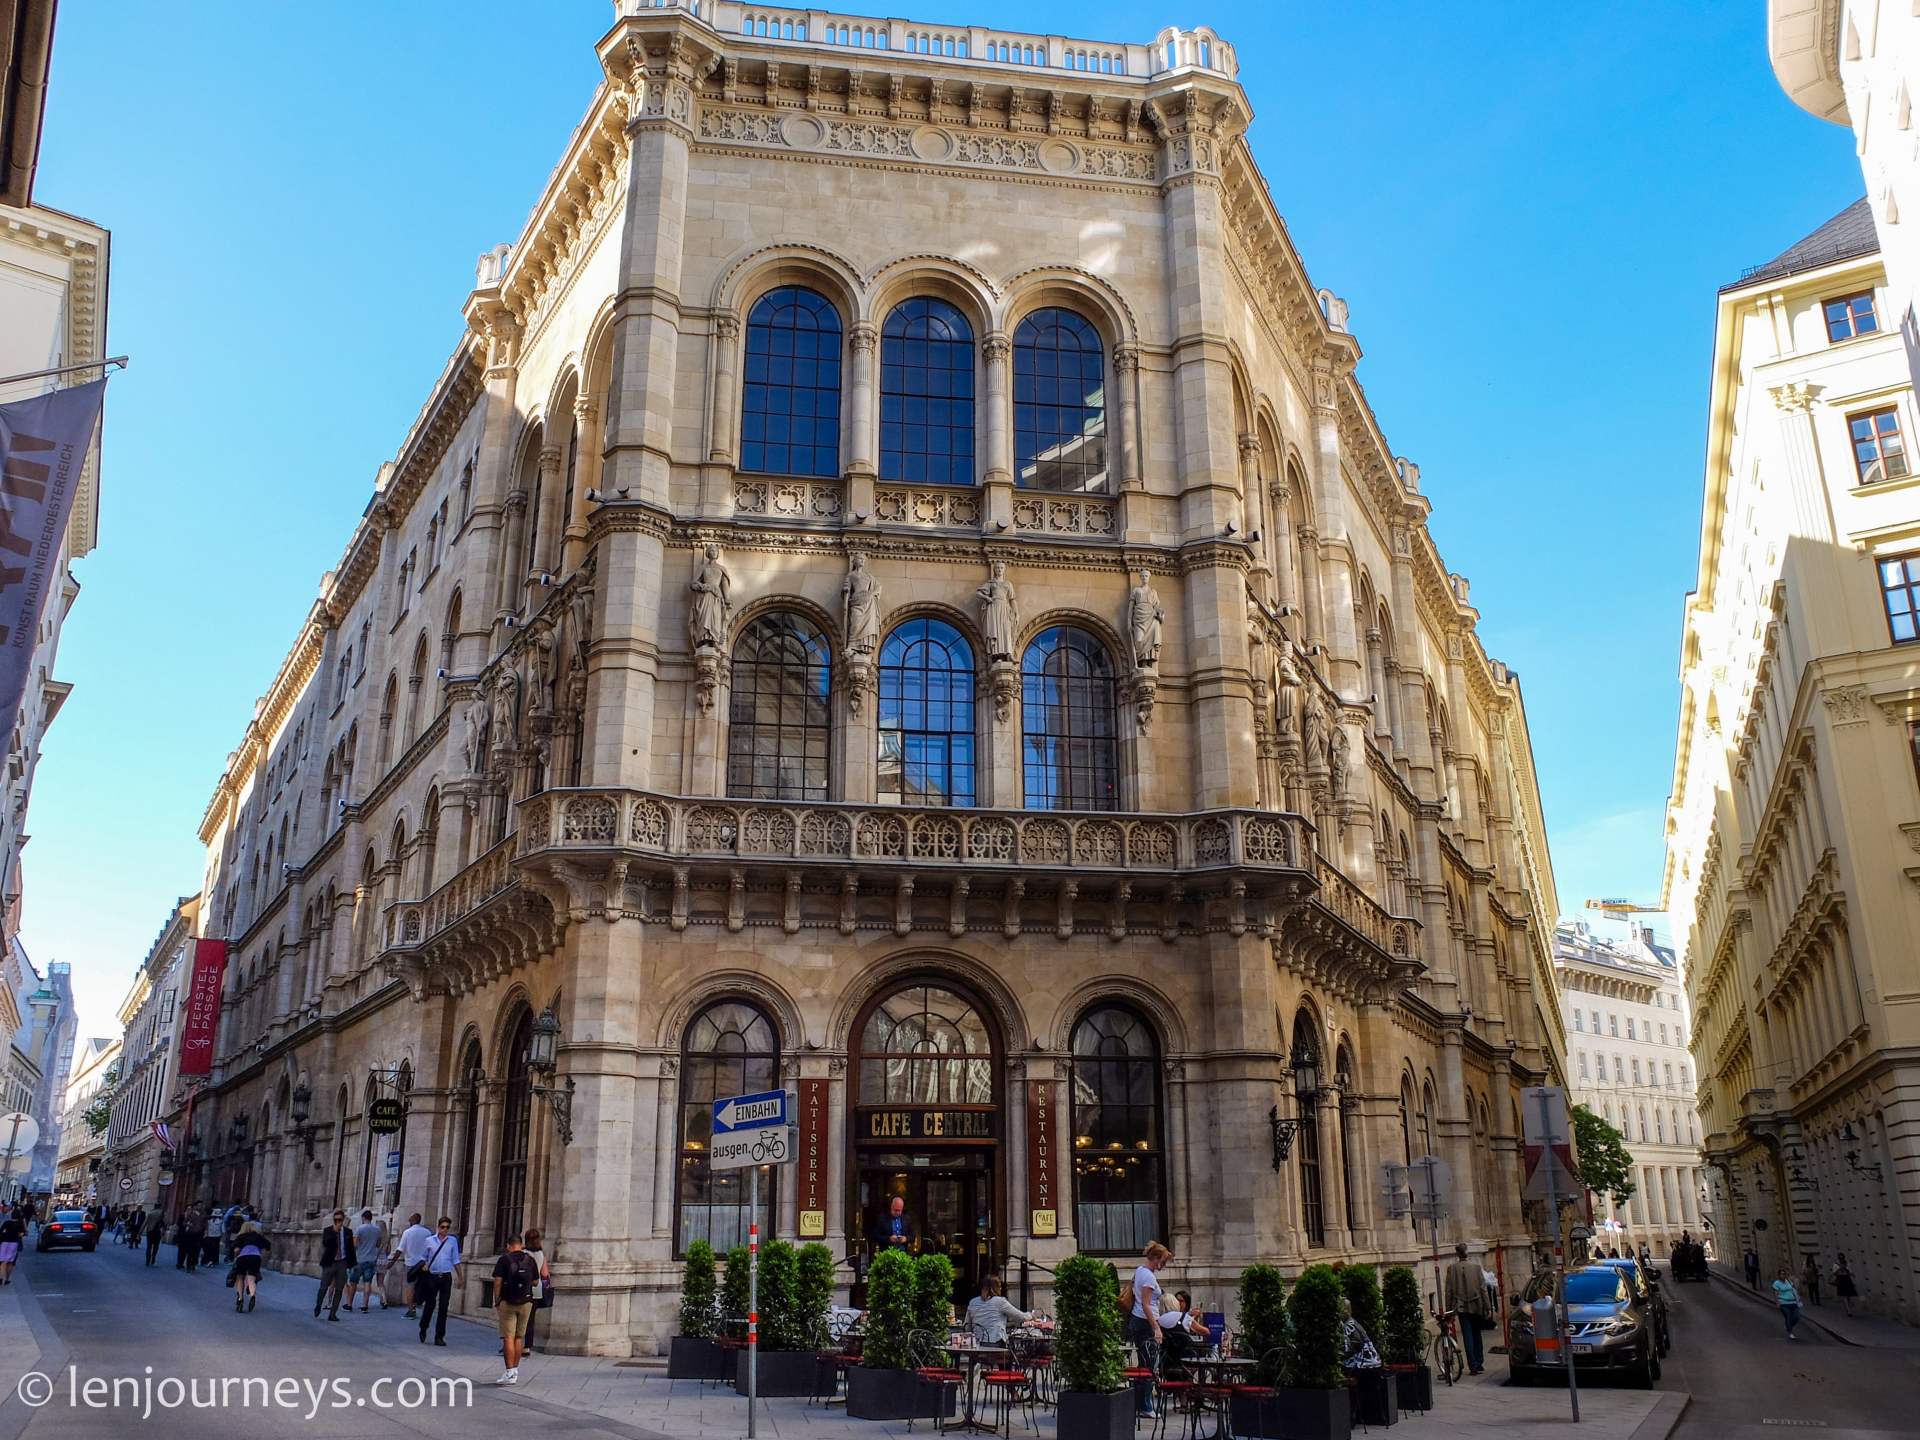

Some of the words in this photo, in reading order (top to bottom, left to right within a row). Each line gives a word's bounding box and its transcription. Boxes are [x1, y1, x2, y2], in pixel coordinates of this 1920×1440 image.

[12, 607, 33, 649] KUNST
[24, 574, 42, 606] RAUM
[34, 443, 74, 570] NIEDEROESTERREICH
[192, 965, 208, 1029] FERSTEL
[201, 965, 218, 1030] PASSAGE
[735, 1101, 778, 1121] EINBAHN
[871, 1113, 912, 1136] CAFE
[923, 1112, 989, 1136] CENTRAL
[712, 1143, 751, 1159] ausgen.
[808, 1082, 819, 1208] PATISSERIE
[1038, 1084, 1048, 1207] RESTAURANT
